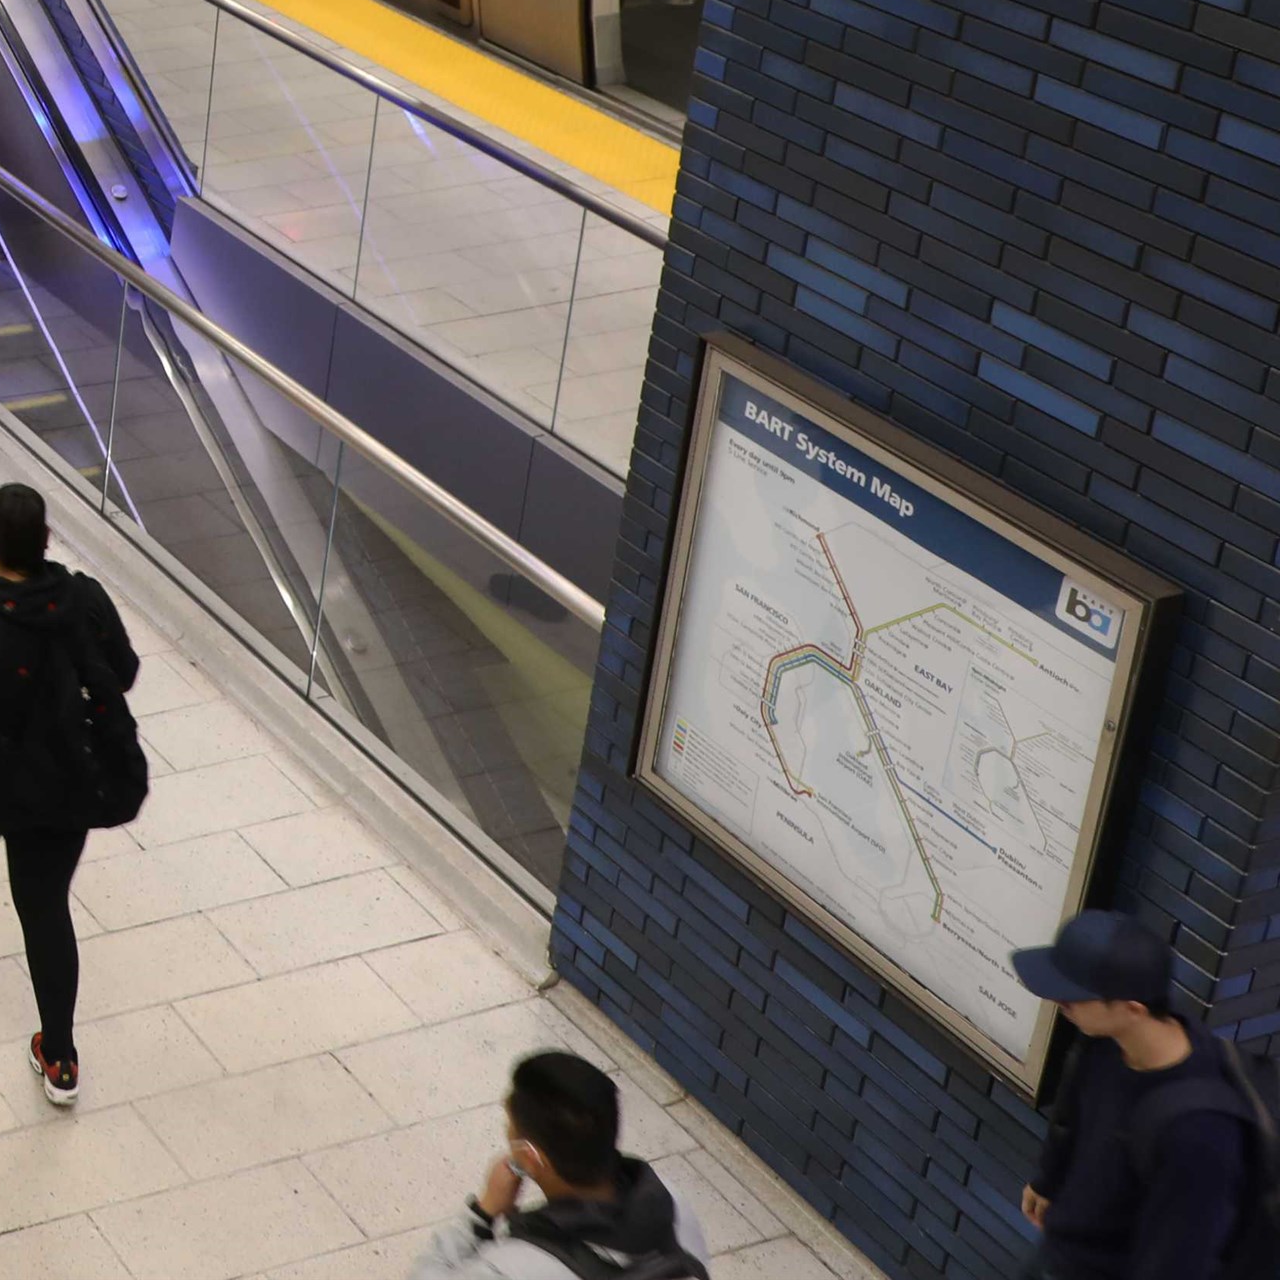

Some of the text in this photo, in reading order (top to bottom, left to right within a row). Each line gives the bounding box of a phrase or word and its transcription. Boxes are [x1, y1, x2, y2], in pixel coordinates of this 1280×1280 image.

[744, 401, 915, 517] BART System Map
[735, 584, 789, 625] SAN FRANCISCO
[914, 664, 935, 683] EAST
[936, 679, 954, 695] BAY
[1039, 664, 1069, 687] Antioch
[864, 678, 902, 708] OAKLAND
[776, 810, 815, 844] PENINSULA
[998, 854, 1039, 887] Pleasanton
[942, 922, 1000, 969] Berryessa/North
[978, 985, 1017, 1019] SAN JOSE
